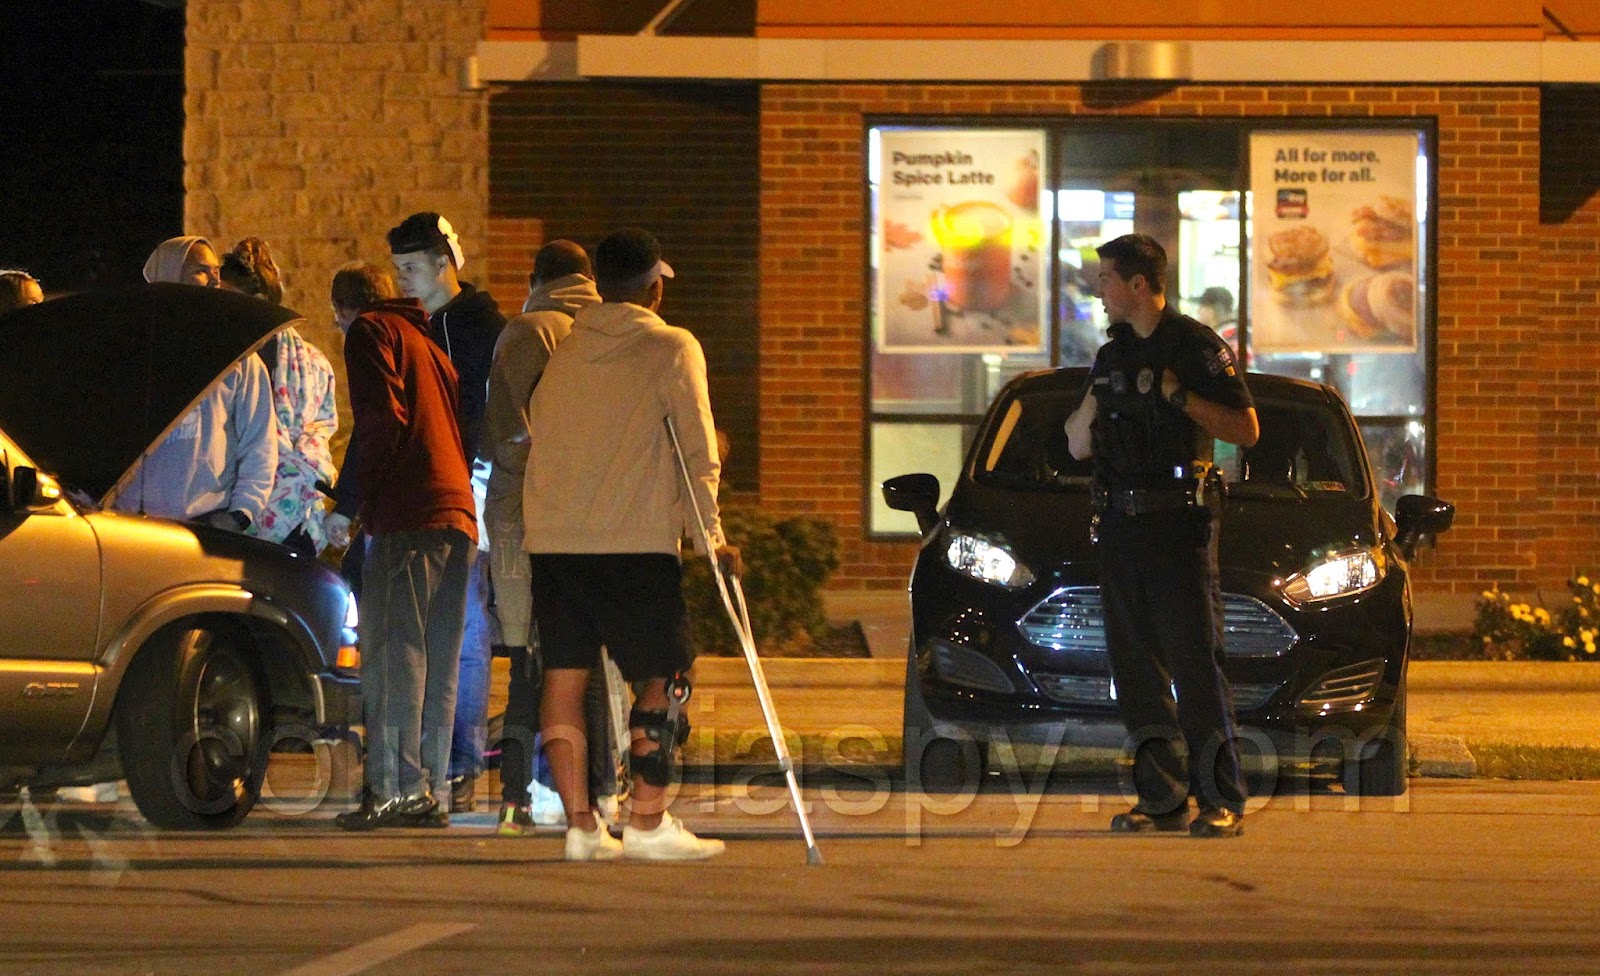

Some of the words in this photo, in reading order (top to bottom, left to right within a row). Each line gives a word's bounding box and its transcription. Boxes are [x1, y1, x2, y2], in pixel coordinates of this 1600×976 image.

[893, 151, 973, 167] Pumpkin
[1275, 148, 1298, 162] All
[1303, 148, 1327, 162] for
[893, 170, 942, 187] Spice
[947, 170, 995, 185] Latte
[1274, 168, 1317, 182] More
[1322, 167, 1345, 182] for
[1349, 166, 1376, 182] all.
